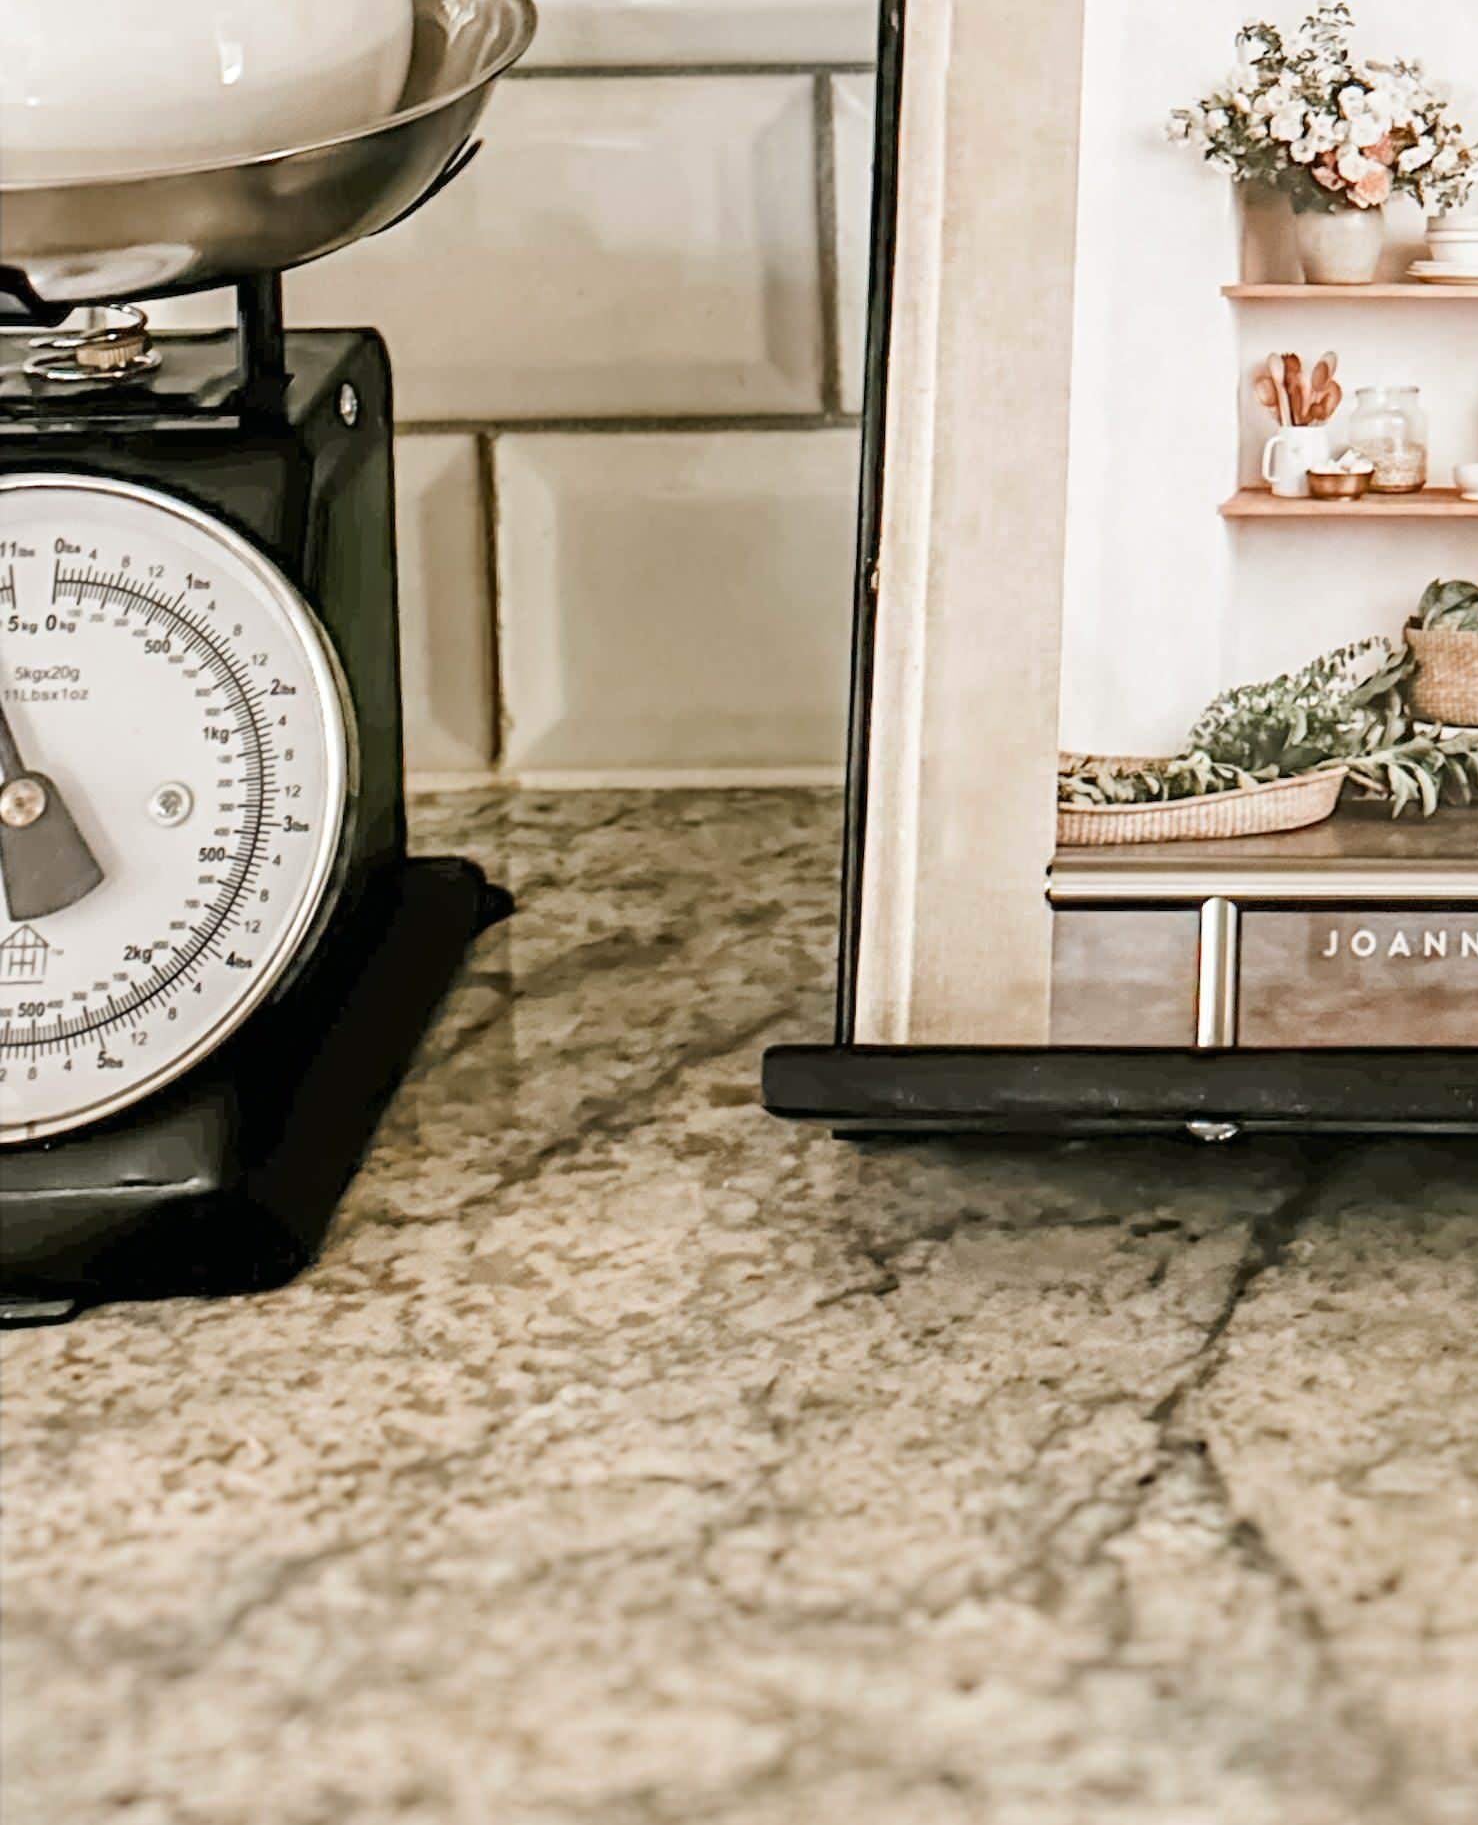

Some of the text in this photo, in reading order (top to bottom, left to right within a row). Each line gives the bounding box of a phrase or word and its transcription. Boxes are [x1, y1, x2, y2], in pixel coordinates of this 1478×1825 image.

[88, 548, 97, 560] 4
[149, 565, 165, 578] 12
[207, 600, 216, 611] 4
[144, 639, 171, 654] 500
[251, 653, 268, 666] 12
[278, 715, 287, 726] 4
[203, 726, 230, 744] 1kg
[285, 784, 302, 798] 12
[198, 847, 226, 863] 500
[272, 854, 281, 866] 4
[244, 920, 262, 934] 12
[123, 945, 153, 964] 2kg
[194, 981, 203, 994] 4
[17, 1001, 47, 1018] 500
[131, 1030, 149, 1047] 12
[64, 1059, 74, 1072] 4
